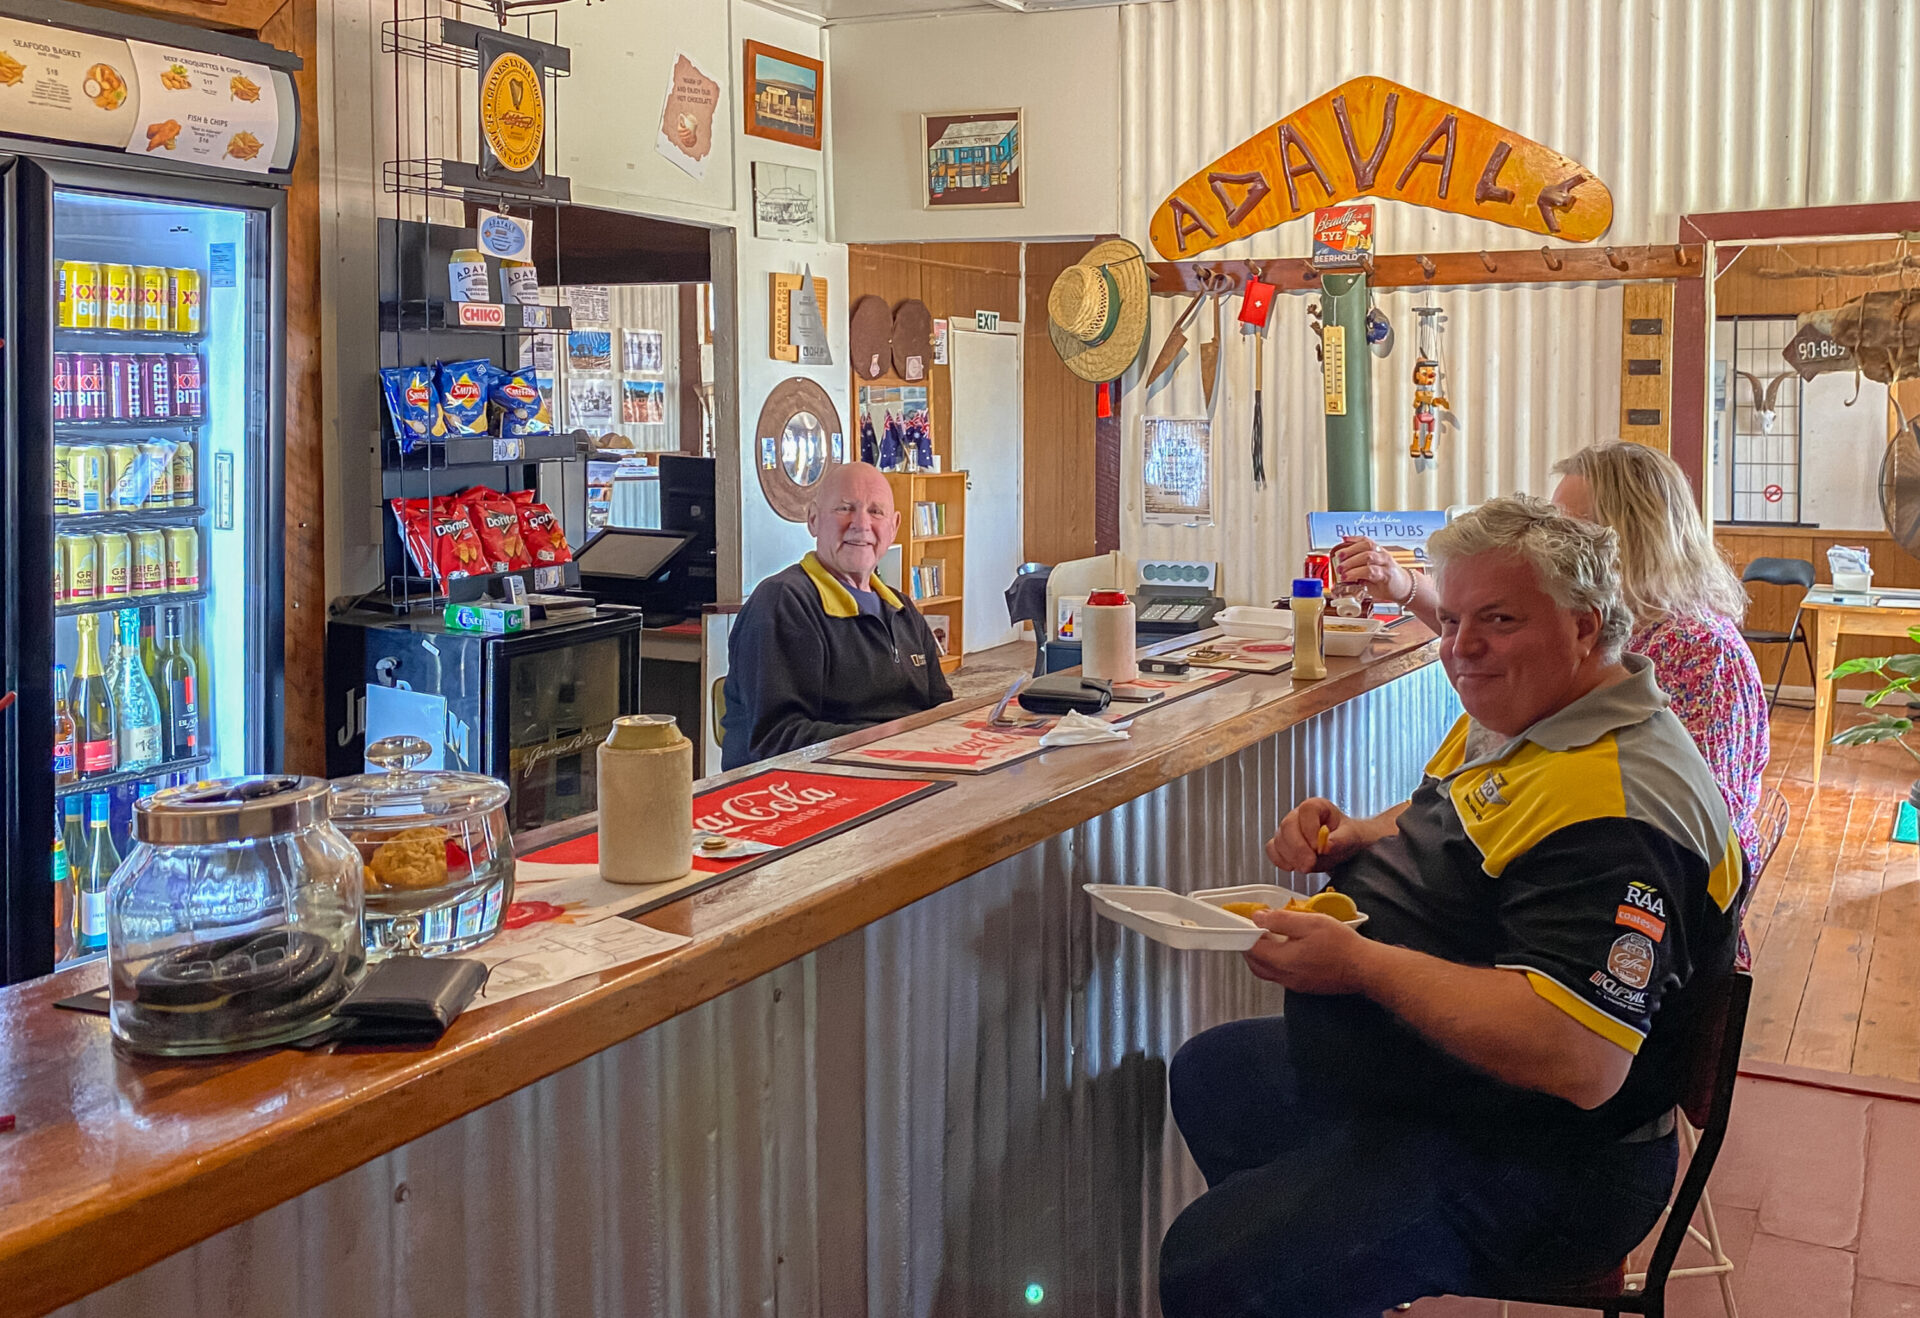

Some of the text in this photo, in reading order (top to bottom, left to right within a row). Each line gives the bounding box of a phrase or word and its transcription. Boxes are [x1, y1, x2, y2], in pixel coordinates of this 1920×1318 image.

[13, 39, 51, 52] SEAFOOD
[52, 47, 81, 58] BASKET
[509, 58, 531, 77] EXTRA
[687, 96, 712, 105] CHOCOLATE
[188, 114, 202, 123] FISH
[210, 118, 228, 128] CHIPS
[1168, 92, 1588, 252] ADAVALE
[1314, 207, 1358, 235] Beauty
[1320, 230, 1343, 242] EYE
[1313, 253, 1369, 263] BEERHOLDR
[457, 264, 487, 280] ADAV
[508, 269, 538, 284] ADAV
[463, 308, 501, 323] CHIKO
[781, 281, 789, 353] EXCELLENCE
[977, 313, 998, 332] EXIT
[127, 364, 140, 418] BITTER
[153, 363, 169, 416] BITTER
[485, 514, 517, 528] Dorito
[1353, 513, 1401, 526] Australian
[1335, 523, 1424, 538] BUSH PUBS
[1623, 885, 1667, 918] RAA
[1618, 911, 1651, 929] coates
[1614, 952, 1647, 973] Coffee
